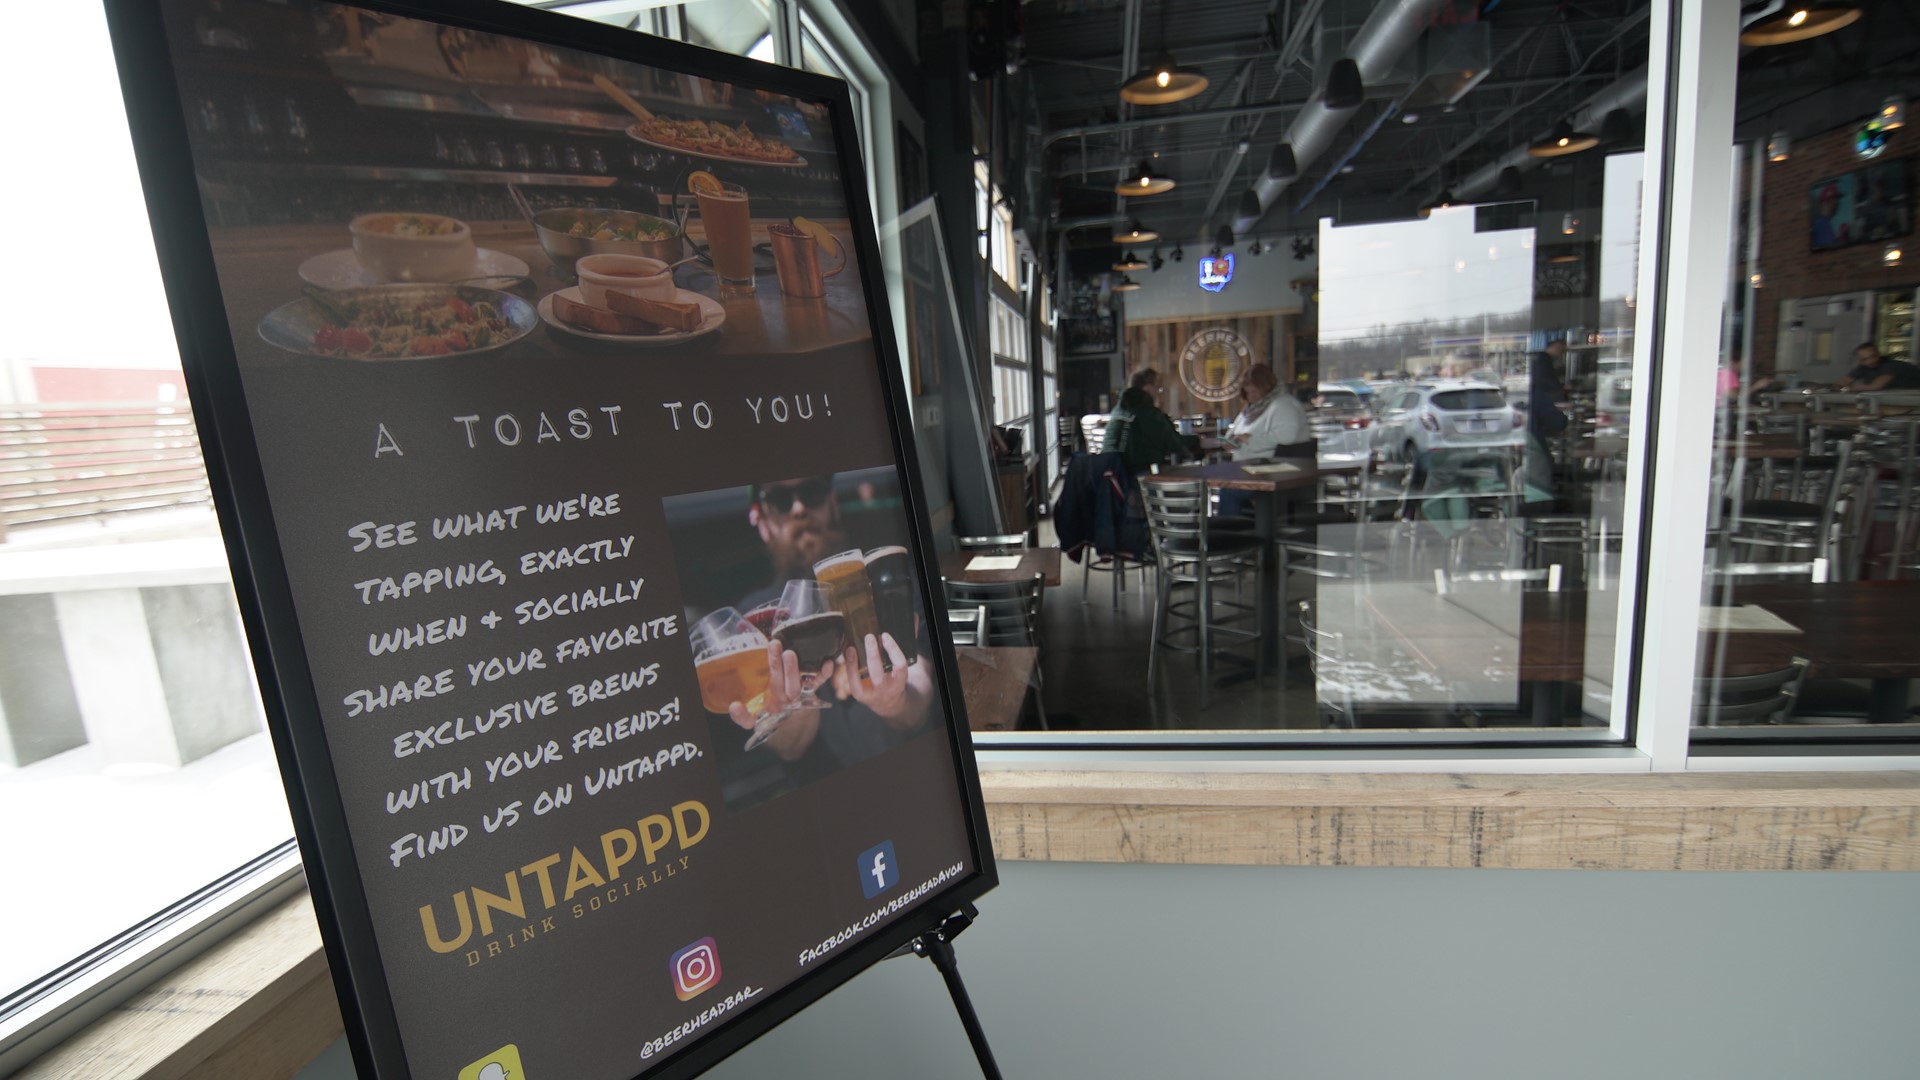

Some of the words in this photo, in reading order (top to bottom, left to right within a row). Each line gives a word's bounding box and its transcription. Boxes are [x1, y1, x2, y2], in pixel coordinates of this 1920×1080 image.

[375, 423, 404, 458] A
[453, 405, 622, 448] TOAST
[663, 400, 714, 430] TO
[746, 394, 832, 424] YOU!
[433, 506, 528, 539] WHAT
[536, 493, 622, 524] WE'RE
[354, 560, 507, 604] TAPPING,
[520, 535, 635, 575] EXACTLY
[369, 615, 468, 656] WHEN
[515, 578, 645, 625] SOCIALLY
[343, 669, 456, 718] SHARE
[467, 648, 547, 686] YOUR
[556, 615, 679, 663] FAVORITE
[393, 692, 559, 758] EXCLUSIVE
[567, 663, 661, 707] BREWS
[385, 767, 472, 815] WITH
[485, 740, 564, 782] YOUR
[572, 697, 681, 754] FRIENDS!
[389, 824, 469, 868] FIND
[483, 801, 523, 833] US
[533, 783, 573, 815] ON
[584, 742, 704, 795] UNTAPPD.
[418, 800, 711, 954] UNTAPPD
[466, 916, 556, 967] DRINK
[573, 855, 691, 918] SOCIALLY
